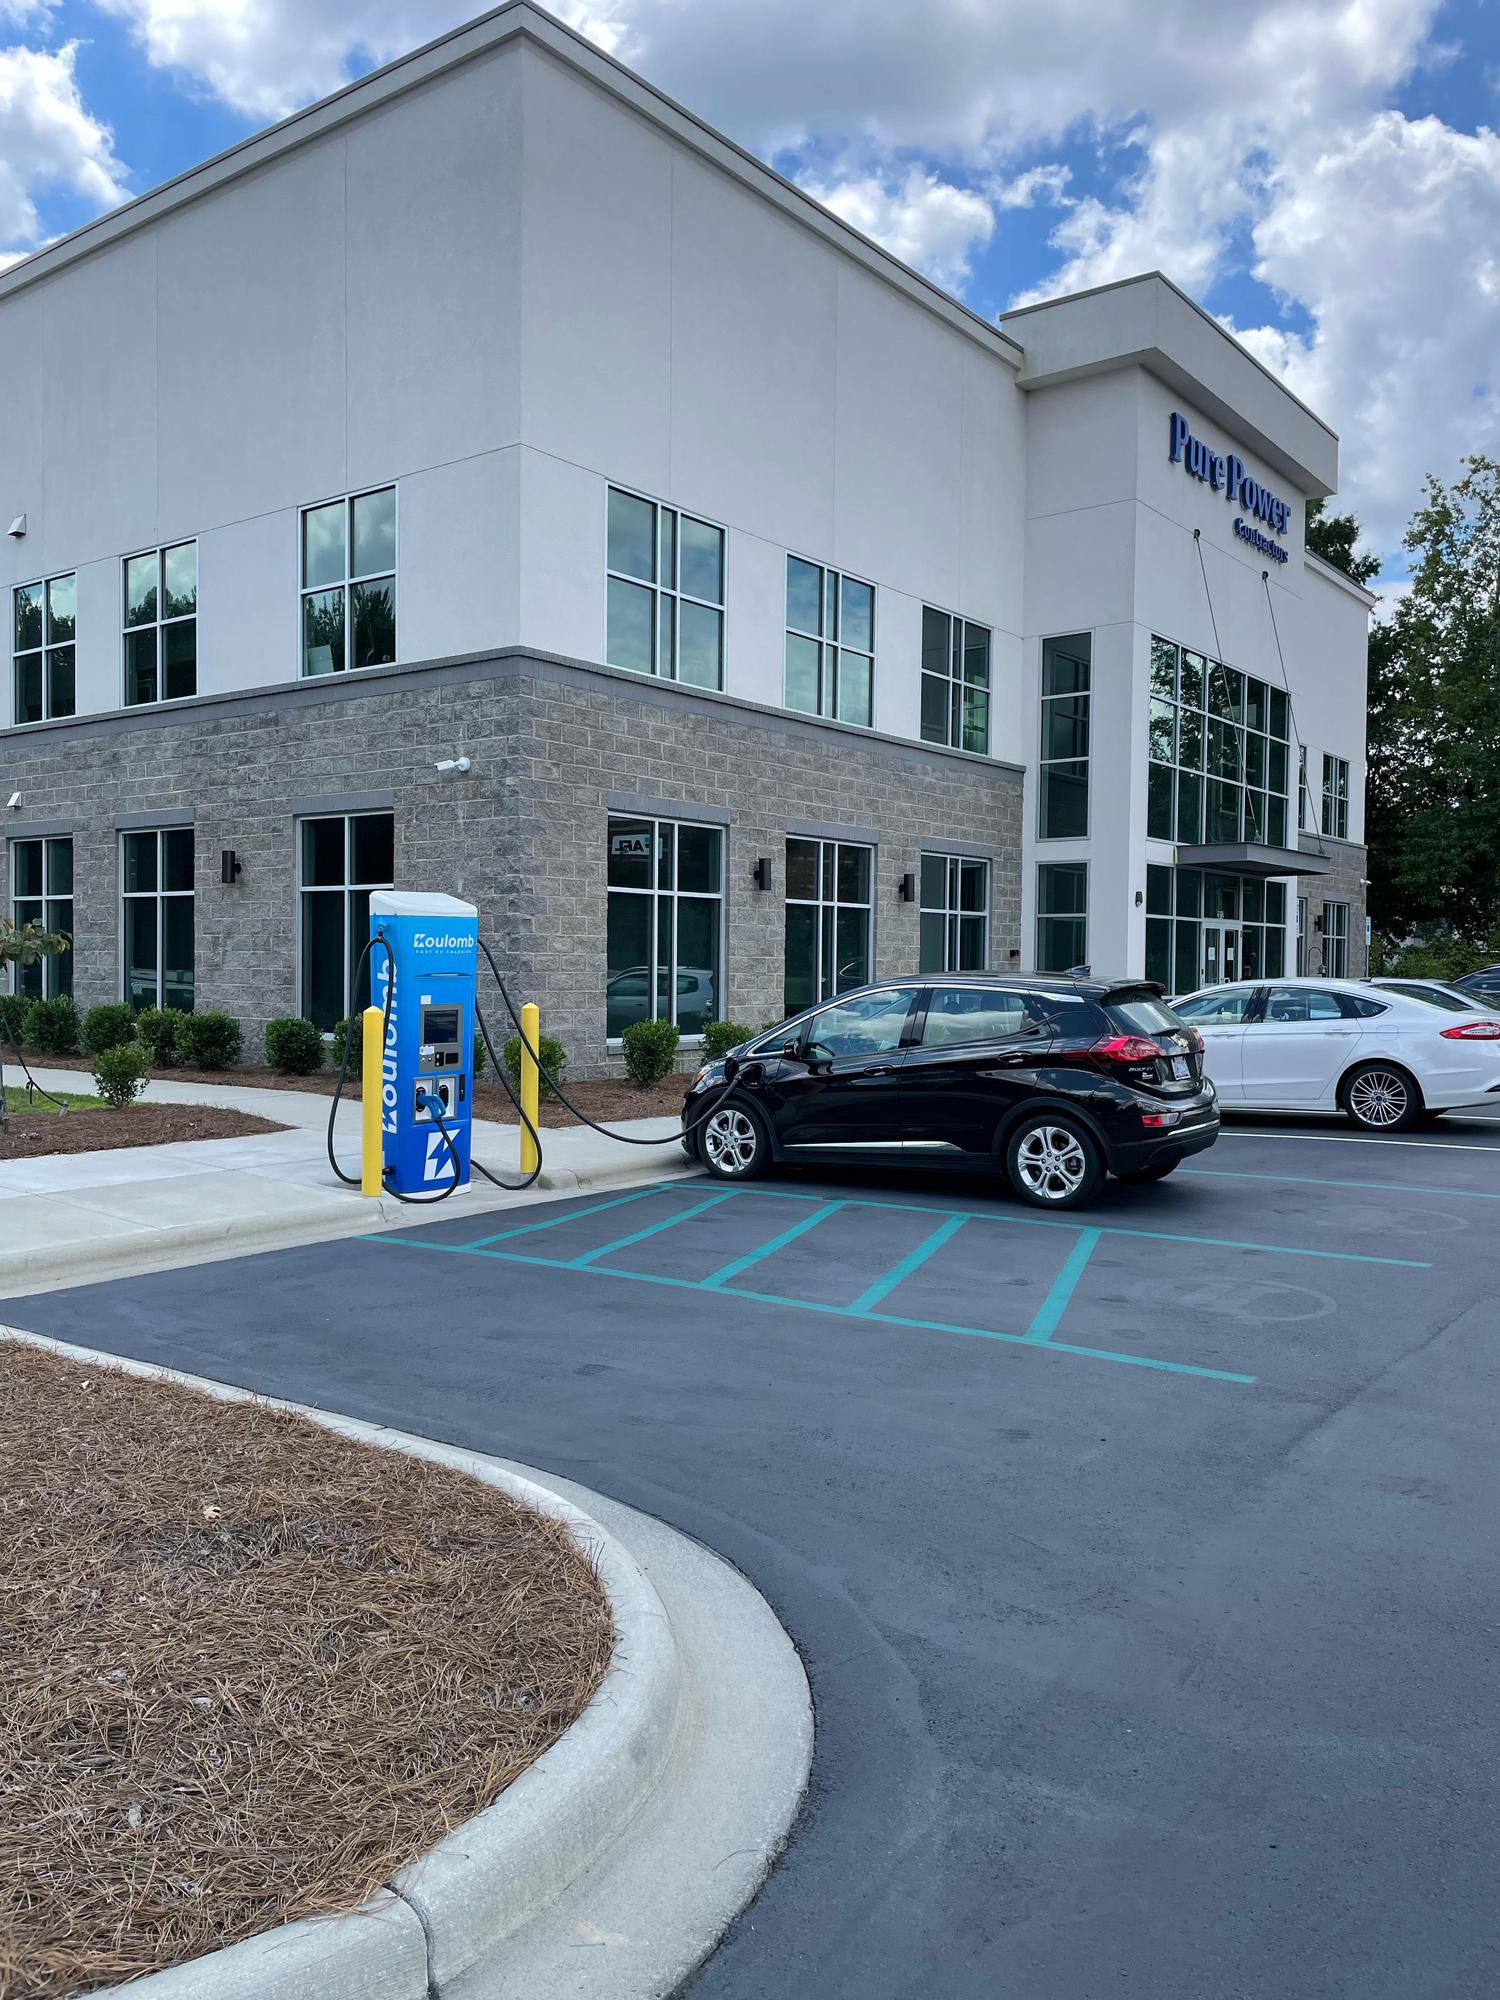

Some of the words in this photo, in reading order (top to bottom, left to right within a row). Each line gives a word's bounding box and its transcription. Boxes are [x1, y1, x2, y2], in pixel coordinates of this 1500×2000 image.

[1170, 412, 1226, 491] Pure
[1226, 454, 1291, 535] Power
[1232, 517, 1289, 564] Contractors
[413, 933, 475, 948] Koulomb
